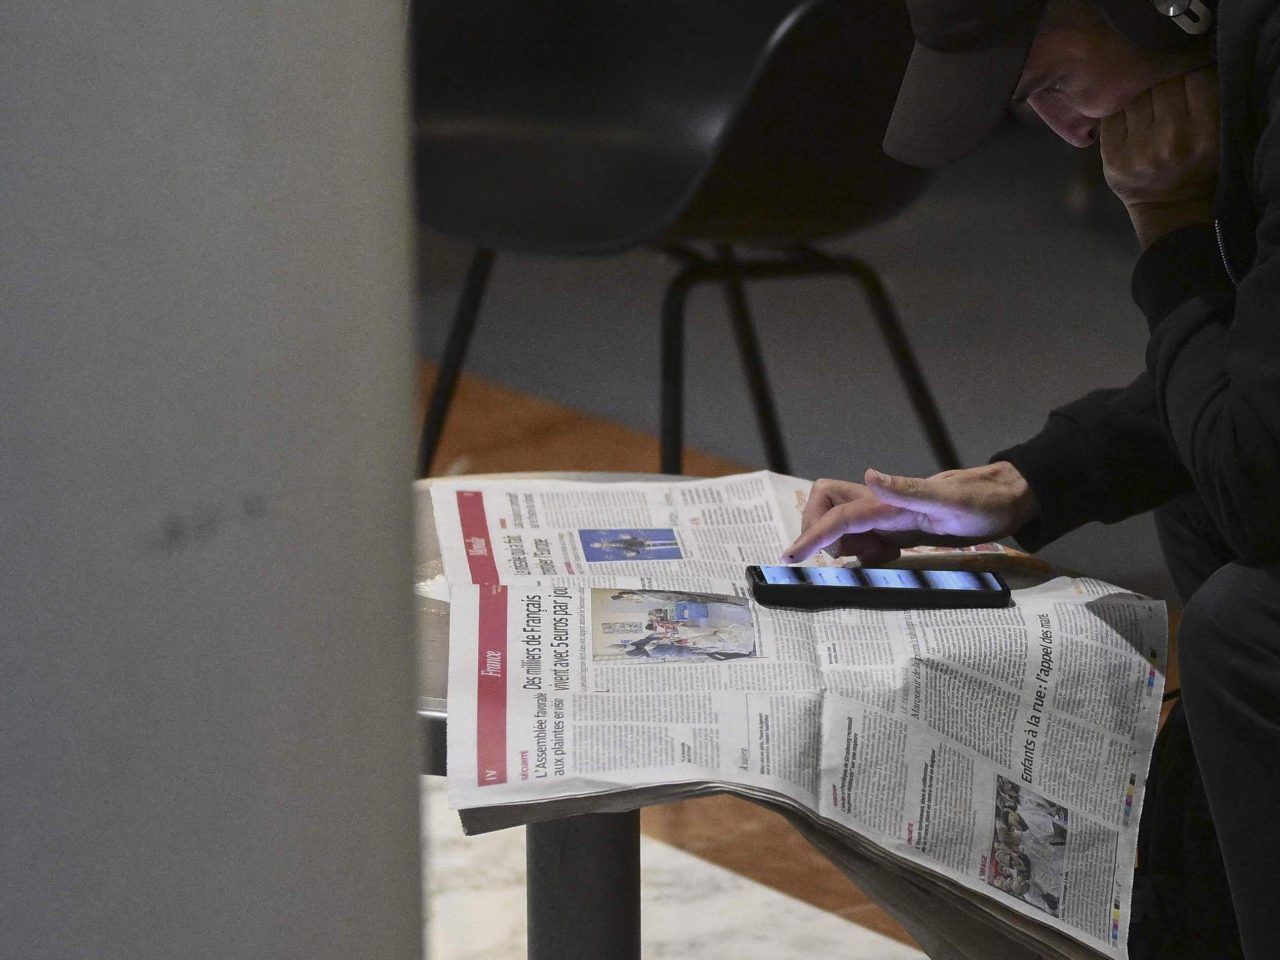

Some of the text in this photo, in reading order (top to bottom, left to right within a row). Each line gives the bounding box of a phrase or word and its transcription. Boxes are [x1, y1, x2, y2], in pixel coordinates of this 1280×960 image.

[548, 586, 573, 599] jou
[553, 600, 573, 616] par
[553, 617, 569, 641] euros
[1039, 630, 1053, 644] des
[521, 595, 547, 690] Des milliers de Français
[481, 650, 501, 677] France
[553, 650, 569, 667] avec
[1036, 644, 1054, 683] l'appel
[548, 669, 570, 691] vivent
[911, 669, 921, 678] de
[911, 680, 923, 720] Marqueur
[1026, 716, 1040, 727] la
[551, 721, 566, 755] plaintes
[1023, 730, 1037, 738] à
[519, 751, 529, 781] SÉCURITÉ
[554, 757, 565, 776] aux
[1020, 739, 1035, 784] Enfants
